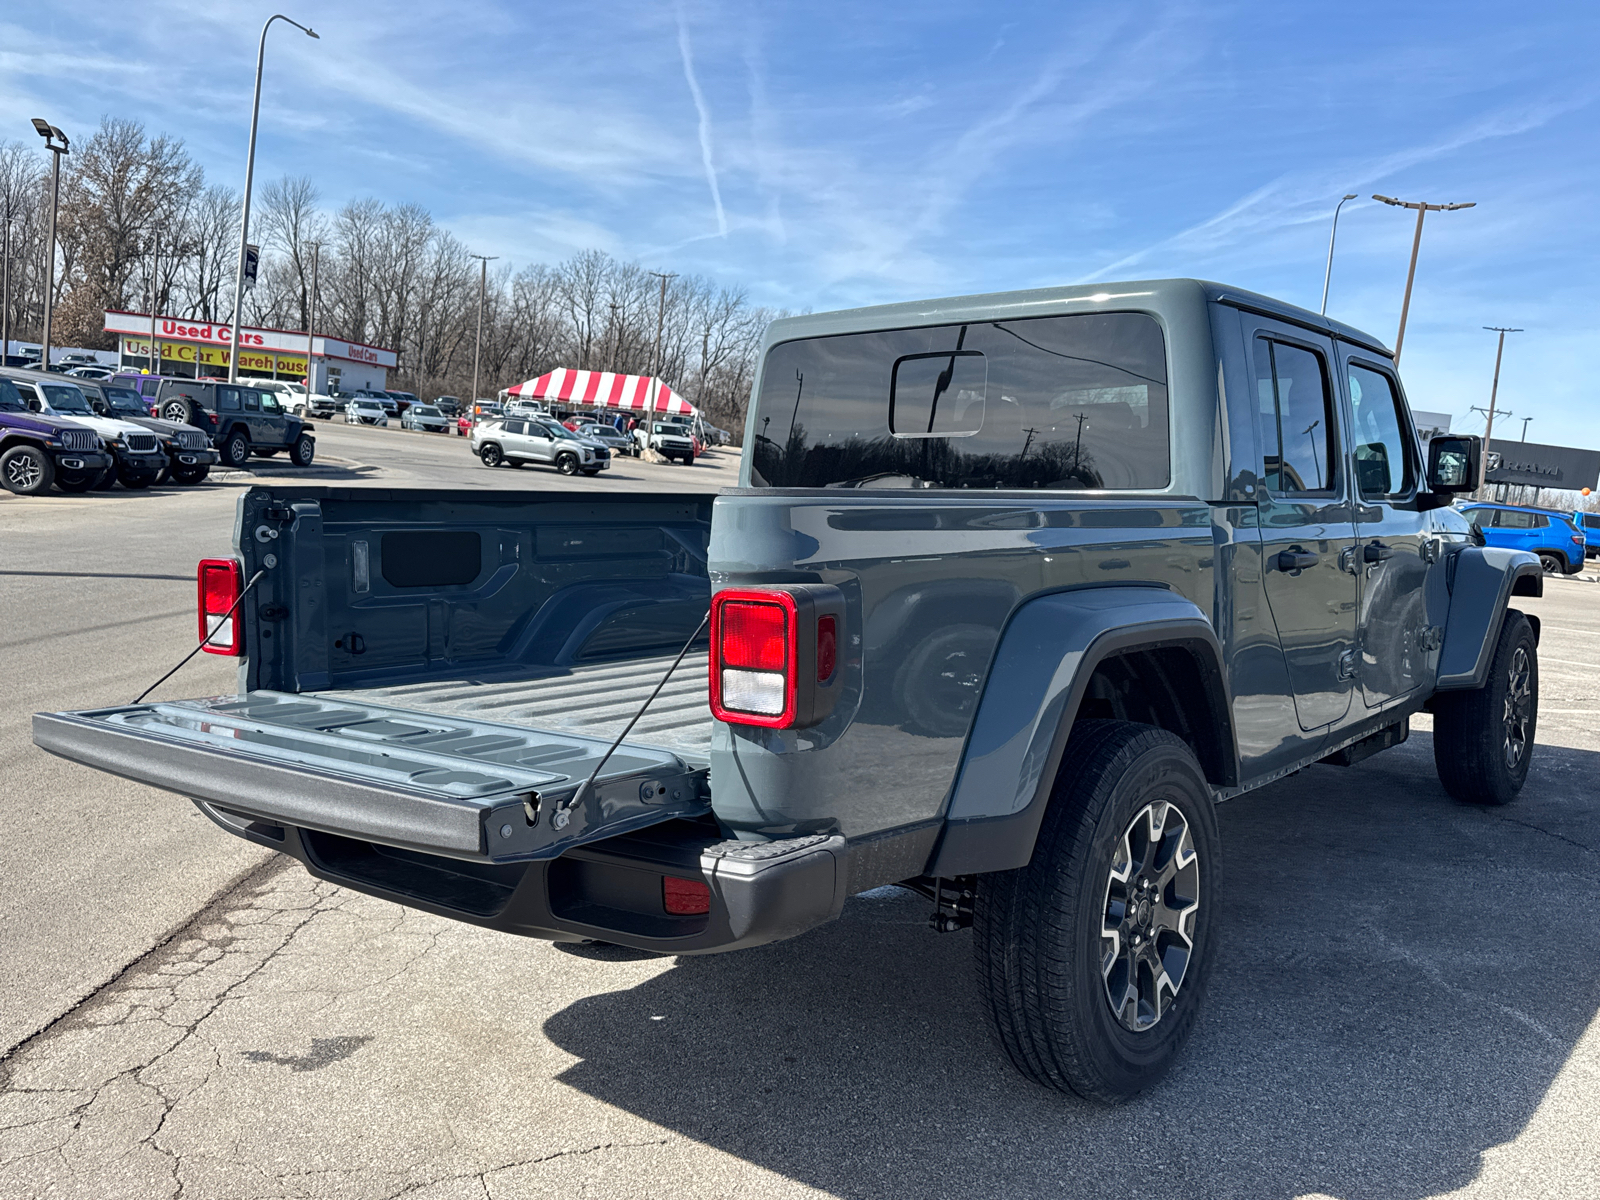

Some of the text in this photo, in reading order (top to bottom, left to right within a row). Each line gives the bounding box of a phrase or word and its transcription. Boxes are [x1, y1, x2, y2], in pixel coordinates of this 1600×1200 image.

[162, 320, 212, 339] Used
[177, 346, 214, 363] Car
[348, 344, 378, 362] Used Cars
[1503, 460, 1559, 476] RAM
